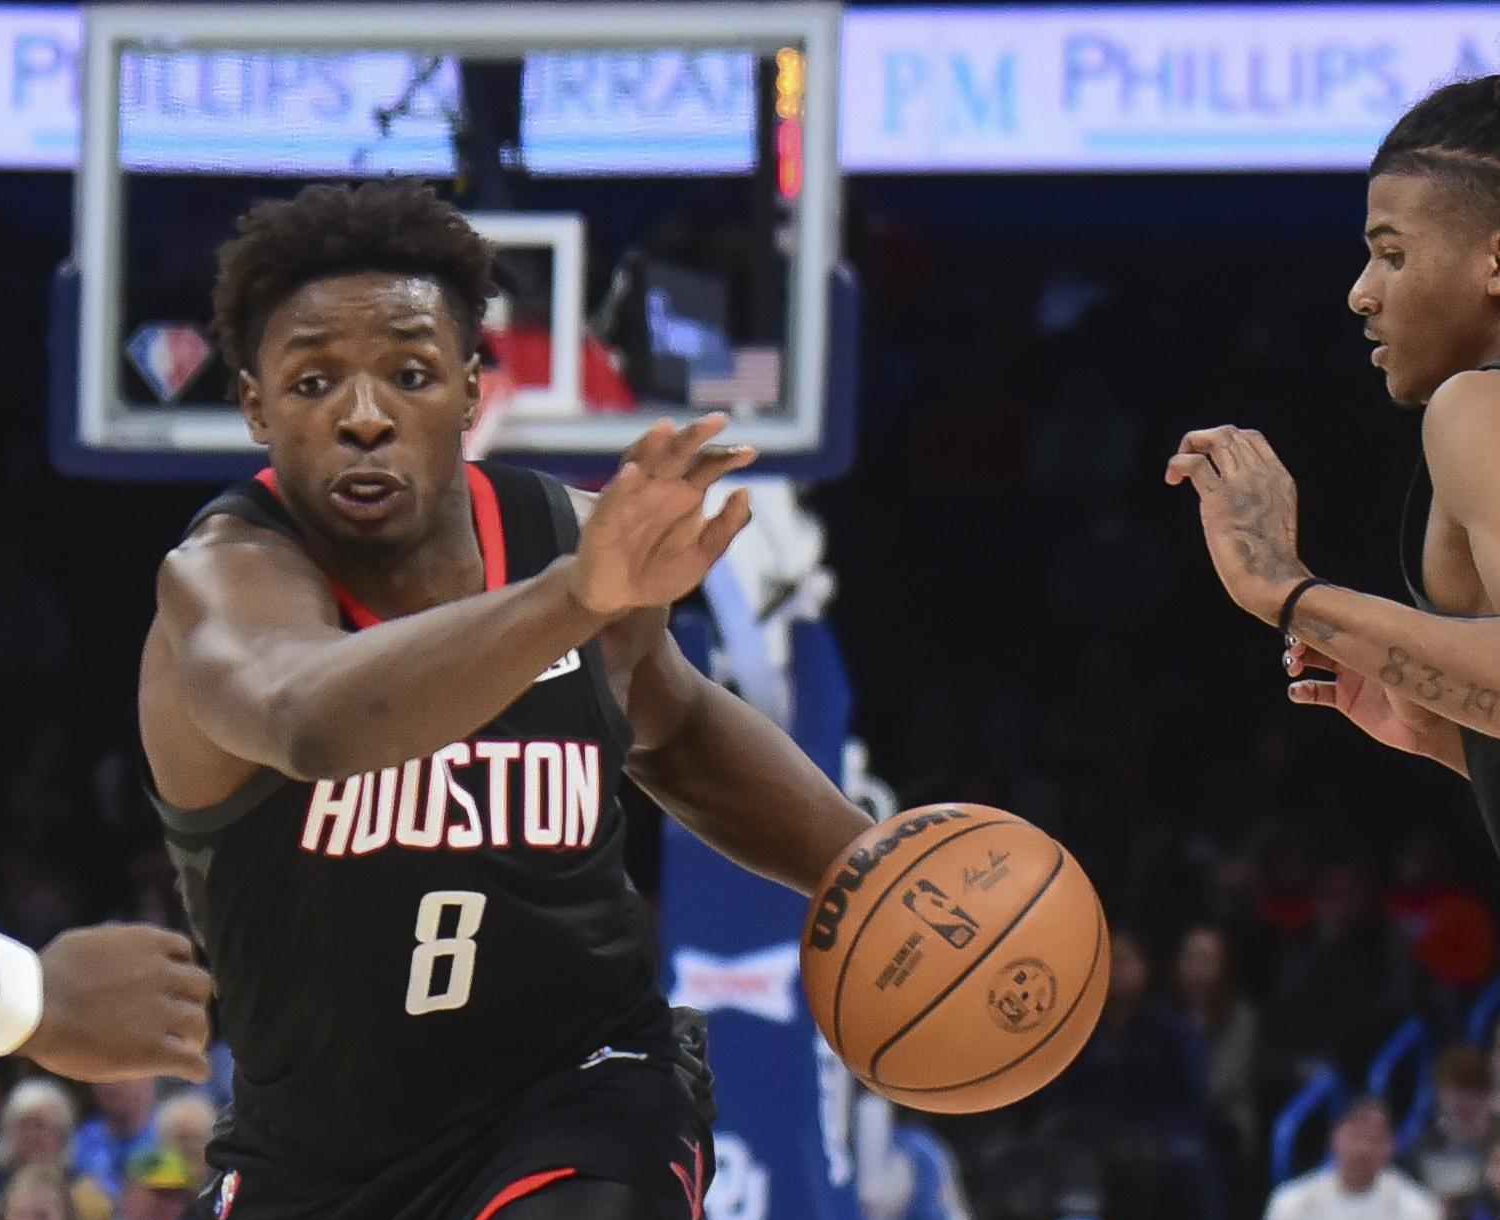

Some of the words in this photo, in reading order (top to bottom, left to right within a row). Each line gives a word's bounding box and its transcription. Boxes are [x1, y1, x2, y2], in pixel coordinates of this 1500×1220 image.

[1061, 28, 1408, 117] PHILLIPS
[299, 738, 601, 858] HOUSTON
[405, 889, 488, 1017] 8
